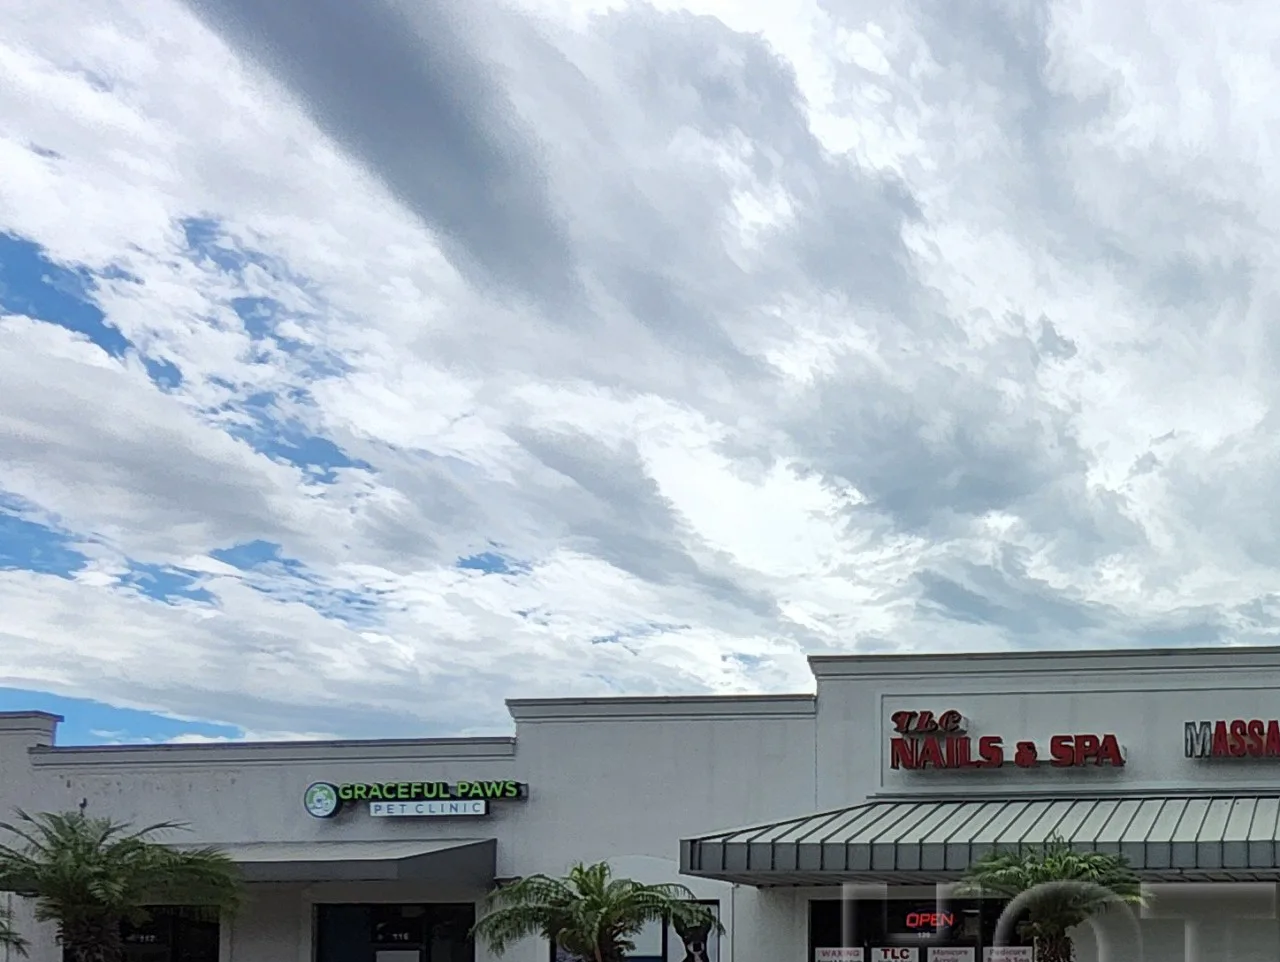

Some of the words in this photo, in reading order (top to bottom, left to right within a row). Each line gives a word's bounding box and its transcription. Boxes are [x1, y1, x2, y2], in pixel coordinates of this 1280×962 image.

[891, 709, 962, 733] TLC
[890, 736, 1004, 769] NAILS
[1014, 741, 1038, 768] &
[1050, 734, 1126, 767] SPA
[338, 782, 451, 799] GRACEFUL
[457, 780, 518, 798] PAWS
[373, 803, 407, 814] PET
[415, 802, 481, 814] CLINIC
[905, 911, 956, 928] OPEN
[881, 948, 909, 959] TLC
